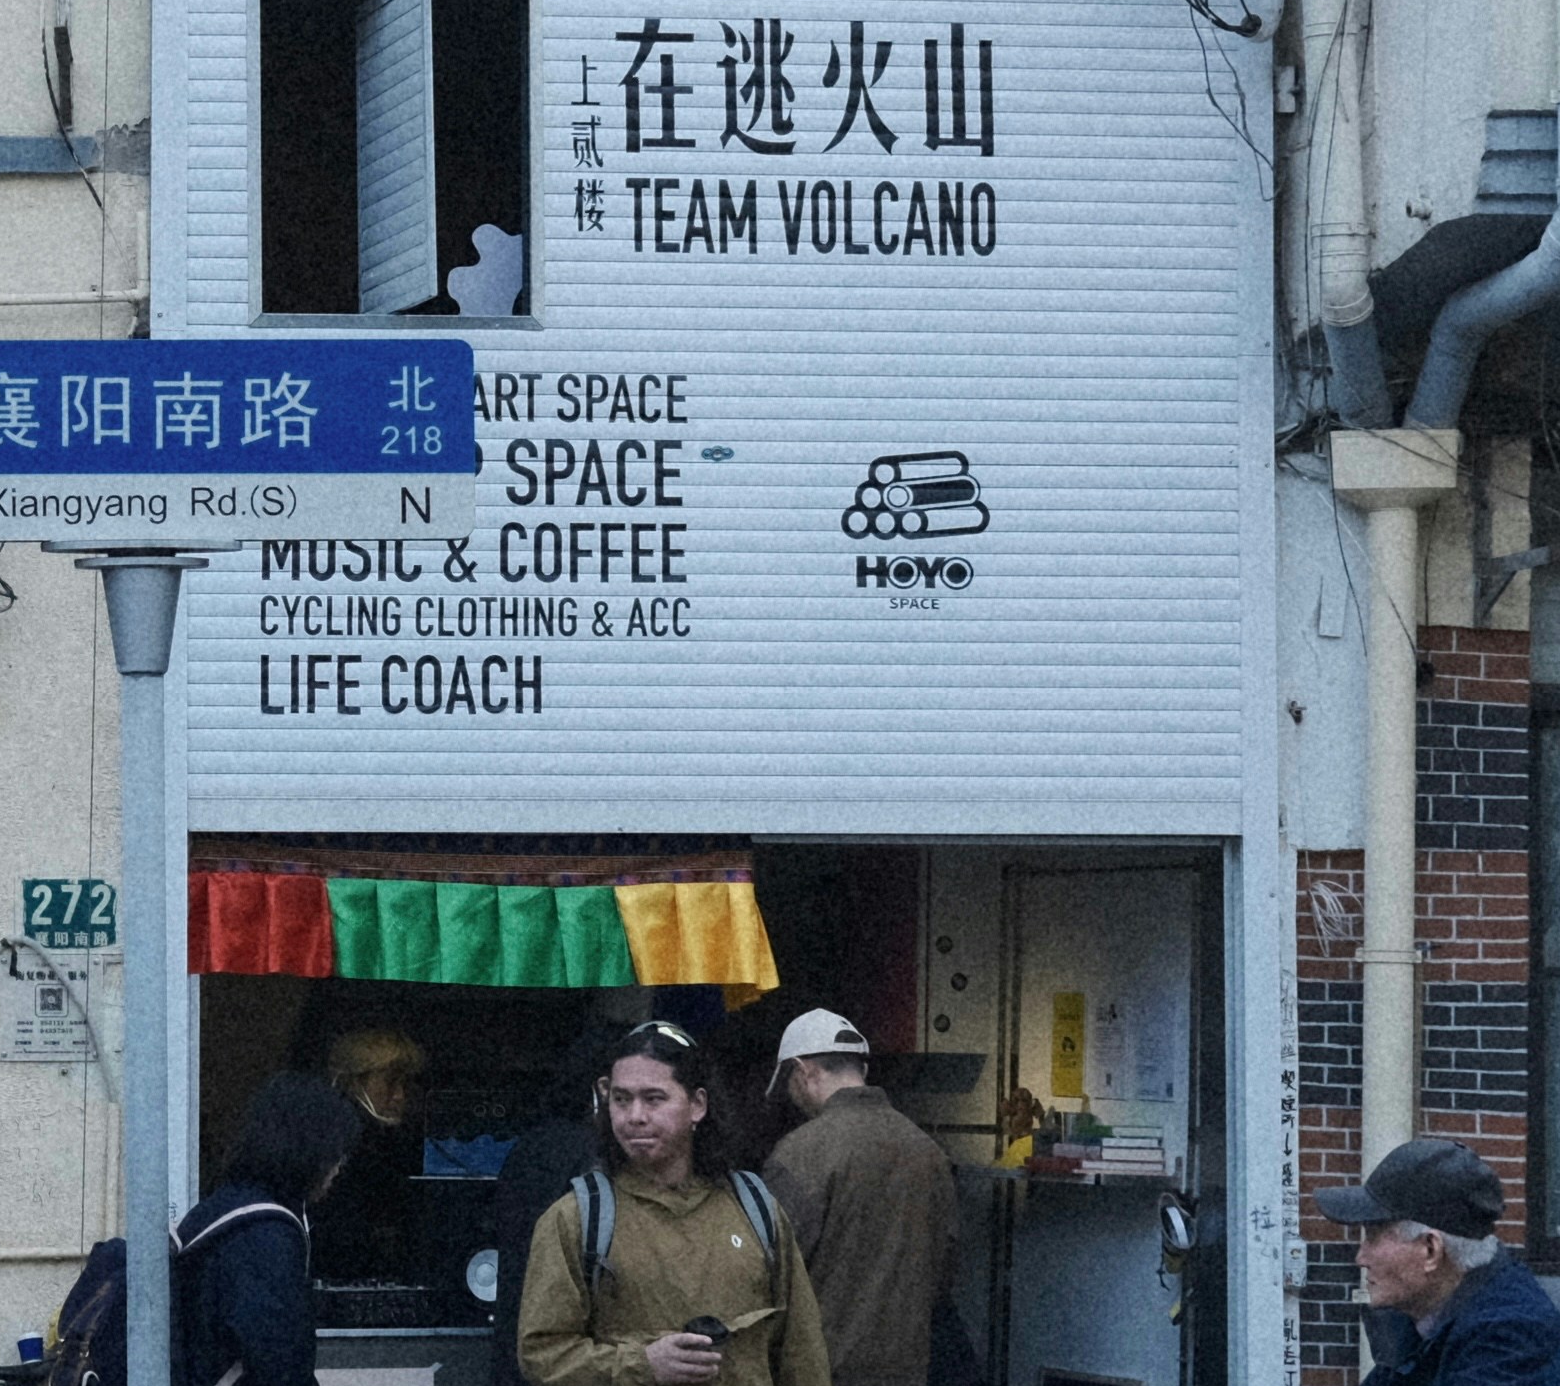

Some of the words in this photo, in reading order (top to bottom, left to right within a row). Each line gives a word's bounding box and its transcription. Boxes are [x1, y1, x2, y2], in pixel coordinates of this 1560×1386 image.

[615, 16, 995, 158] 在逃火山
[570, 53, 606, 235] 上贰楼
[625, 178, 757, 255] TEAM
[779, 178, 997, 257] VOLCANO
[388, 364, 436, 413] 北
[556, 373, 688, 425] SPACE
[380, 424, 443, 457] 218
[506, 438, 685, 508] SPACE
[190, 484, 299, 520] Rd.(S)
[399, 486, 433, 524] N
[260, 538, 421, 583] MUSIC
[443, 532, 479, 585] &
[498, 523, 688, 584] COFFEE
[856, 555, 974, 590] HOYO
[259, 596, 402, 639] CYCLING
[414, 596, 578, 638] CLOTHING
[590, 596, 615, 638] &
[627, 596, 692, 638] ACC
[889, 597, 941, 610] SPACE
[259, 655, 363, 715] LIFE
[380, 655, 543, 715] COACH
[30, 883, 112, 926] 272
[34, 930, 110, 947] 襄阳南路
